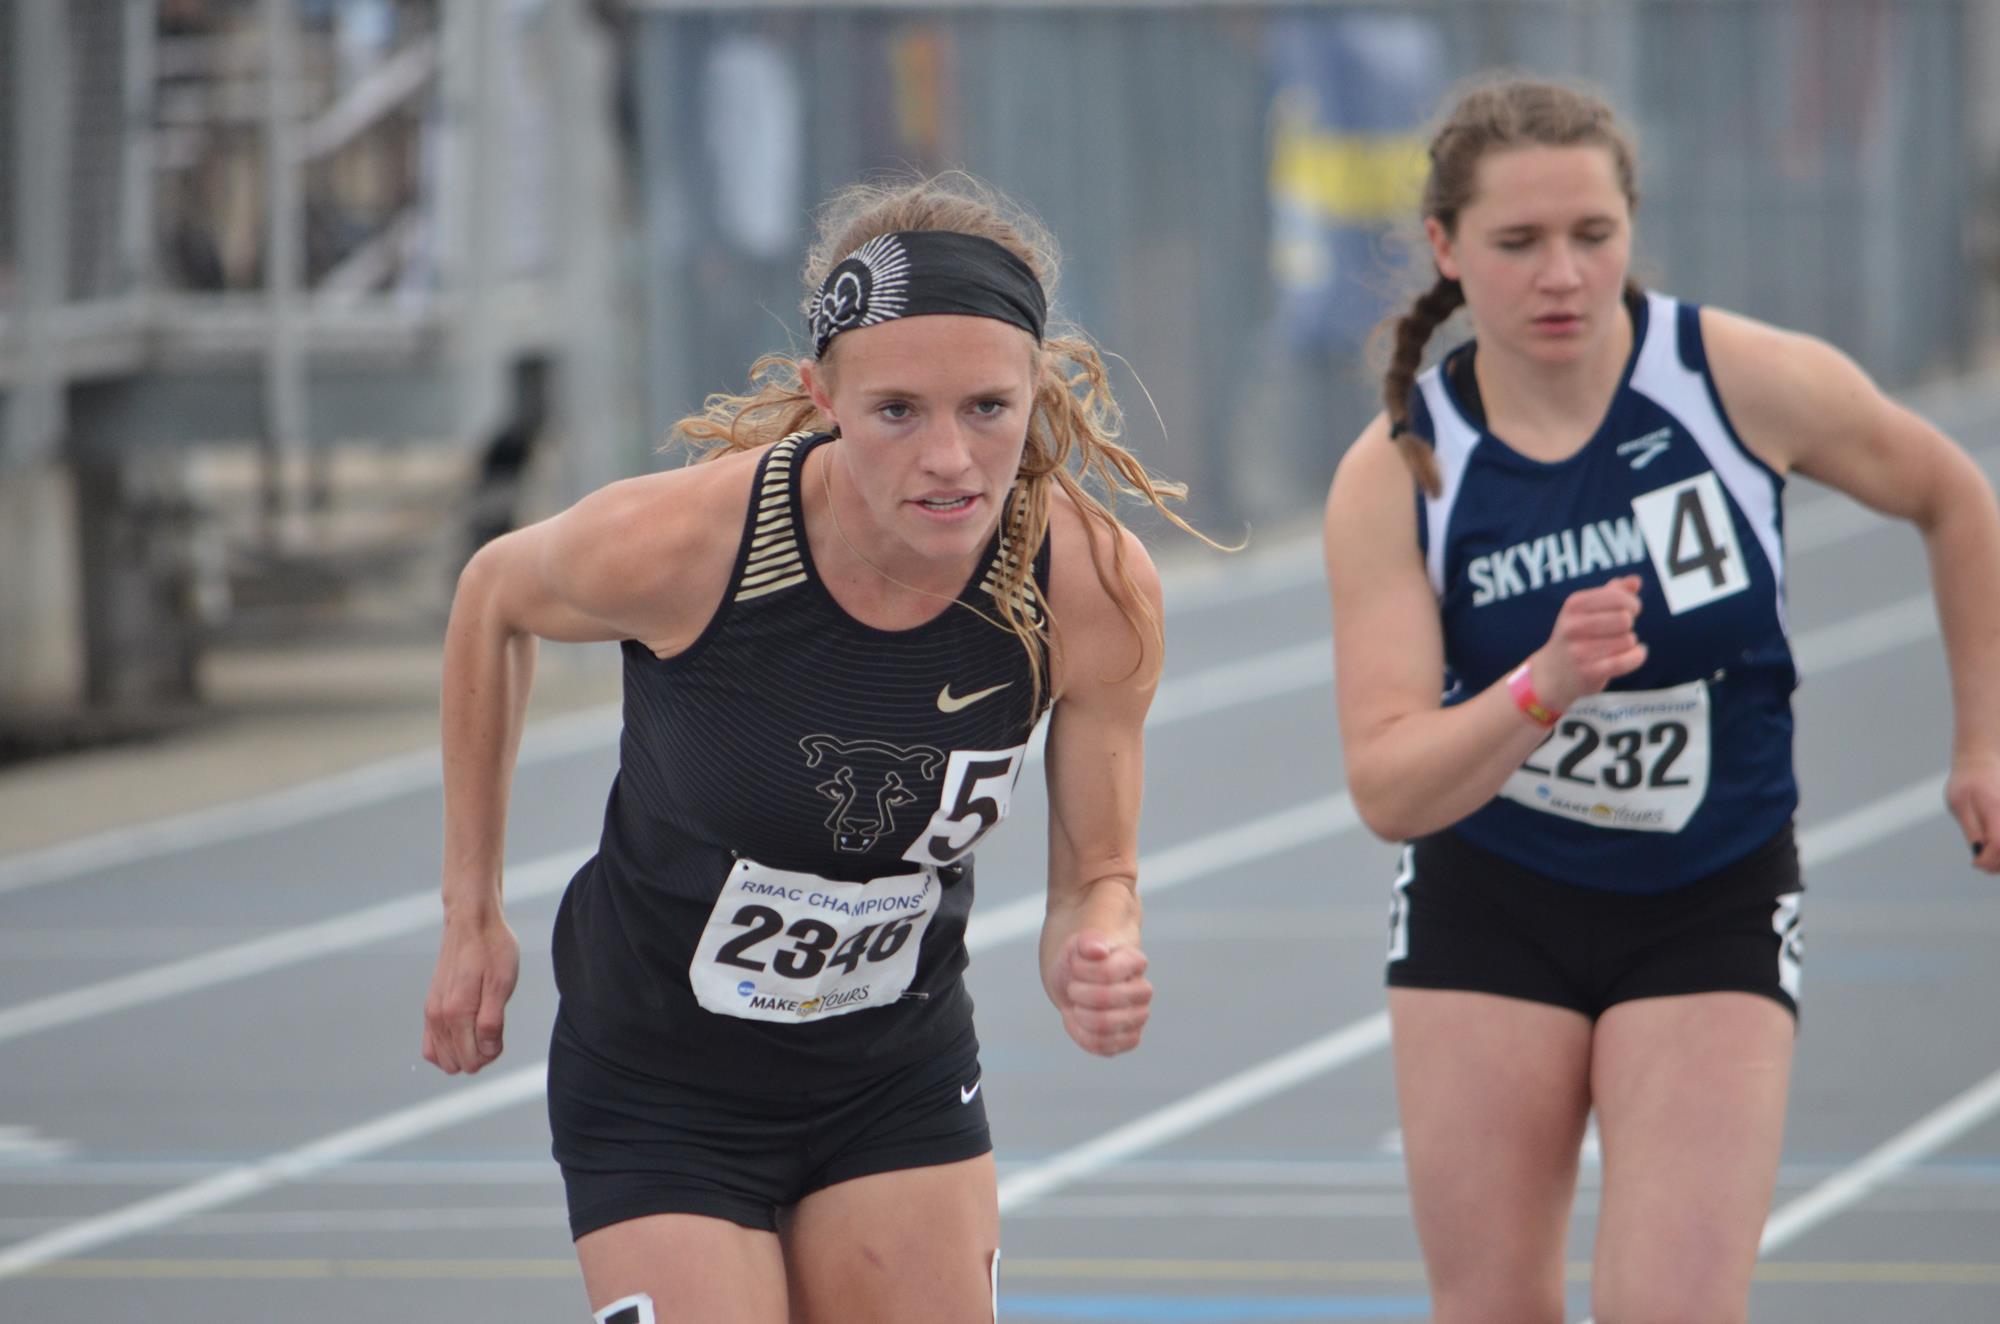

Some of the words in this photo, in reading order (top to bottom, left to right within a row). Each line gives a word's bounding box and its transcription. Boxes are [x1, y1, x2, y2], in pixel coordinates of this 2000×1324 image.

[1667, 487, 1728, 588] 4
[928, 756, 1013, 862] 5
[741, 880, 803, 901] RMAC
[713, 904, 927, 980] 2346
[749, 996, 799, 1012] MAKE
[818, 985, 871, 1013] YOURS
